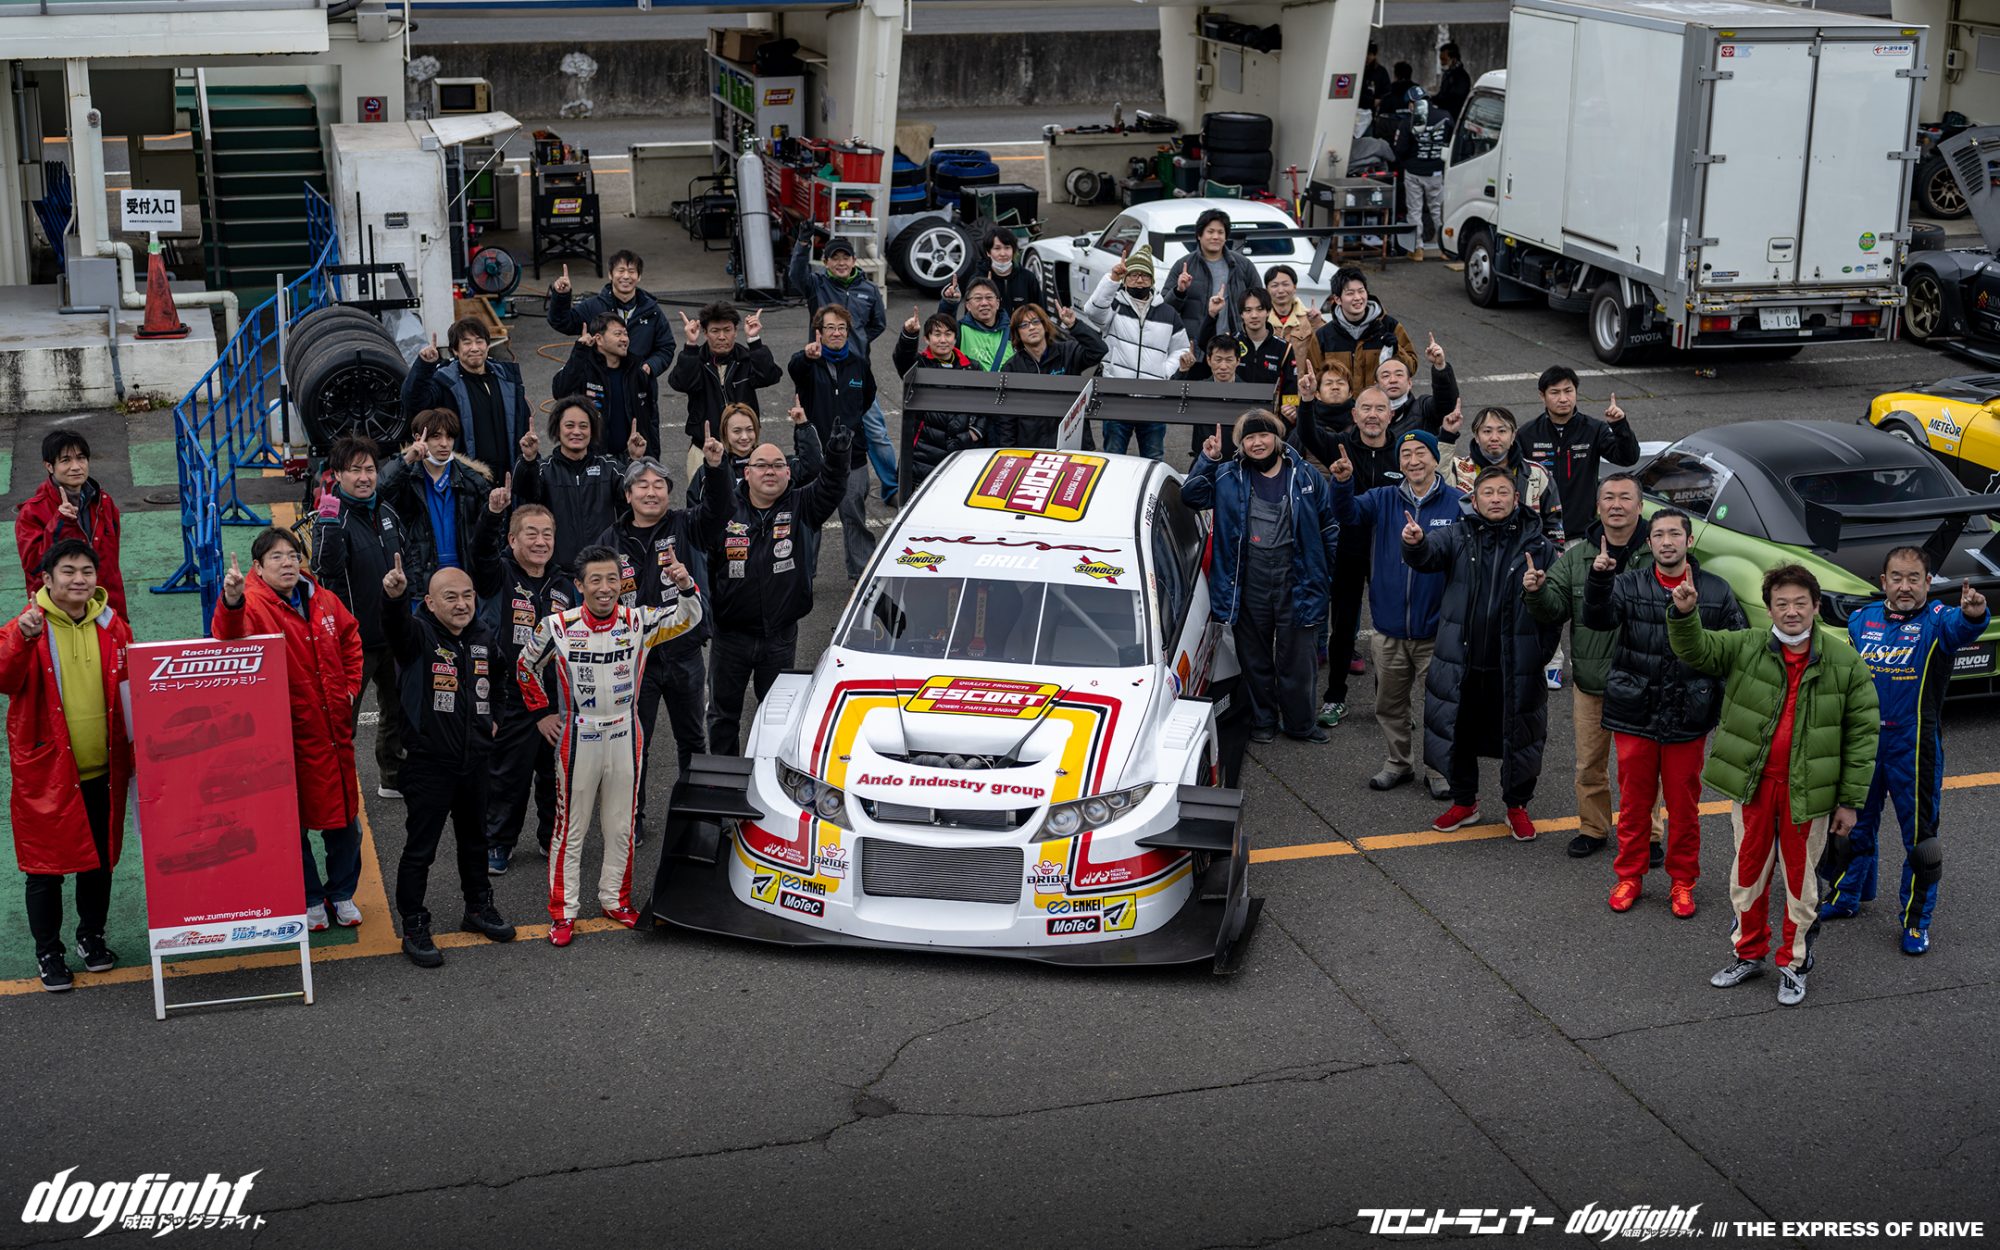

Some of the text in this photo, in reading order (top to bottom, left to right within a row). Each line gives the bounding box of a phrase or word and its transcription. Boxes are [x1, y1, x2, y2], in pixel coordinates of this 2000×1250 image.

[126, 197, 175, 215] 受付入口
[1630, 332, 1663, 344] TOYOTA
[1928, 418, 1962, 438] METEOR
[1011, 452, 1068, 511] ESCORT
[899, 555, 943, 565] SUNOCO
[974, 554, 1041, 570] BRILL
[1077, 564, 1122, 576] SUNOCO
[181, 645, 265, 657] Racing Family
[568, 646, 635, 665] ESCORT
[148, 656, 263, 681] Zummy
[149, 675, 267, 692] ズミーレーシングファミリー
[922, 687, 1047, 706] ESCORT
[856, 773, 1046, 799] Ando industry group
[811, 855, 850, 871] BRIDE
[1026, 874, 1070, 884] BRIDE
[802, 879, 827, 897] ENKEI
[783, 894, 821, 914] MoTeC
[1072, 899, 1101, 913] ENKEI
[183, 907, 273, 923] www.zummyracing.jp
[1052, 917, 1097, 933] MoTeC
